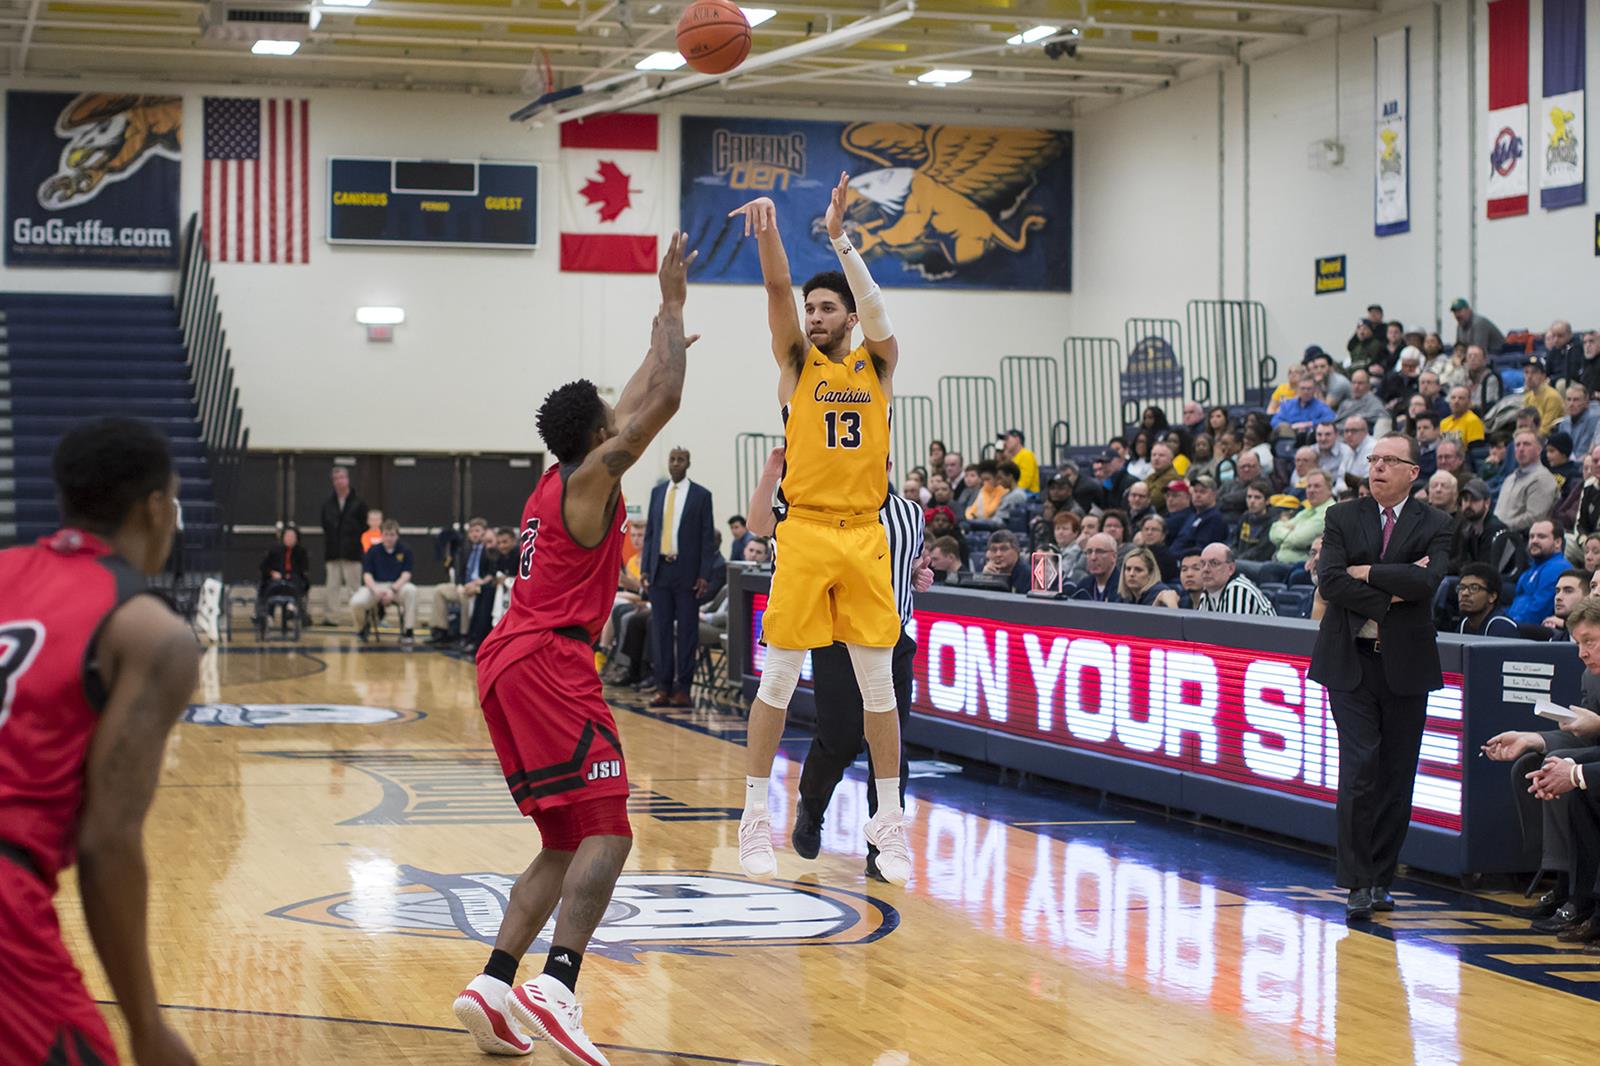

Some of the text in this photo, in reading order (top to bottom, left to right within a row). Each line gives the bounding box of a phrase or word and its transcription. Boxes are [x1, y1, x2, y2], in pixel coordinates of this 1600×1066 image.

[333, 191, 389, 207] CANISIUS
[484, 196, 524, 210] GUEST
[13, 217, 172, 248] GoGriffs.com
[813, 380, 872, 404] Canisius
[824, 410, 862, 449] 13
[927, 620, 1009, 713] ON
[1022, 637, 1218, 765] YOUR
[1242, 659, 1463, 816] SIE
[586, 759, 621, 781] JSU
